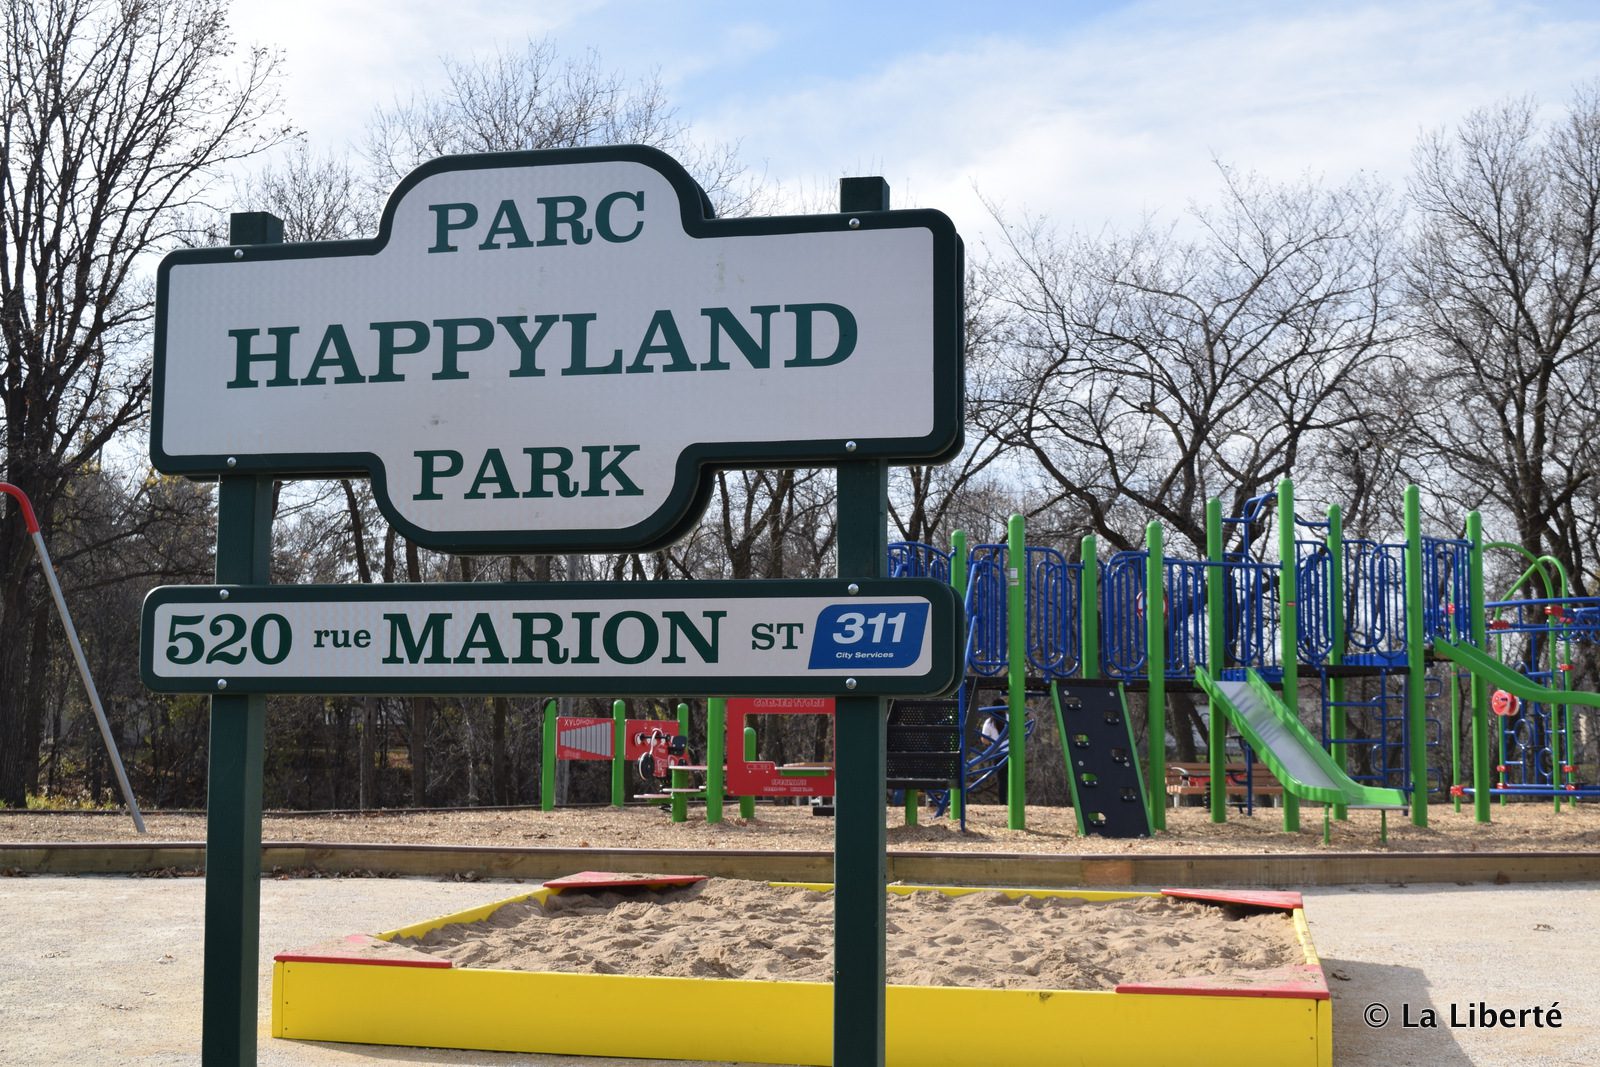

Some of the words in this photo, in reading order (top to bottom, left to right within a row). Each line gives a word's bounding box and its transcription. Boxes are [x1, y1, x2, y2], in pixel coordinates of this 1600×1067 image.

[428, 191, 644, 253] PARC
[227, 303, 858, 389] HAPPYLAND
[413, 445, 644, 501] PARK
[166, 613, 292, 665] 520
[313, 629, 371, 648] rue
[382, 611, 727, 664] MARION
[751, 623, 803, 650] ST
[833, 612, 907, 643] 311
[835, 651, 853, 660] City
[855, 651, 894, 659] Services
